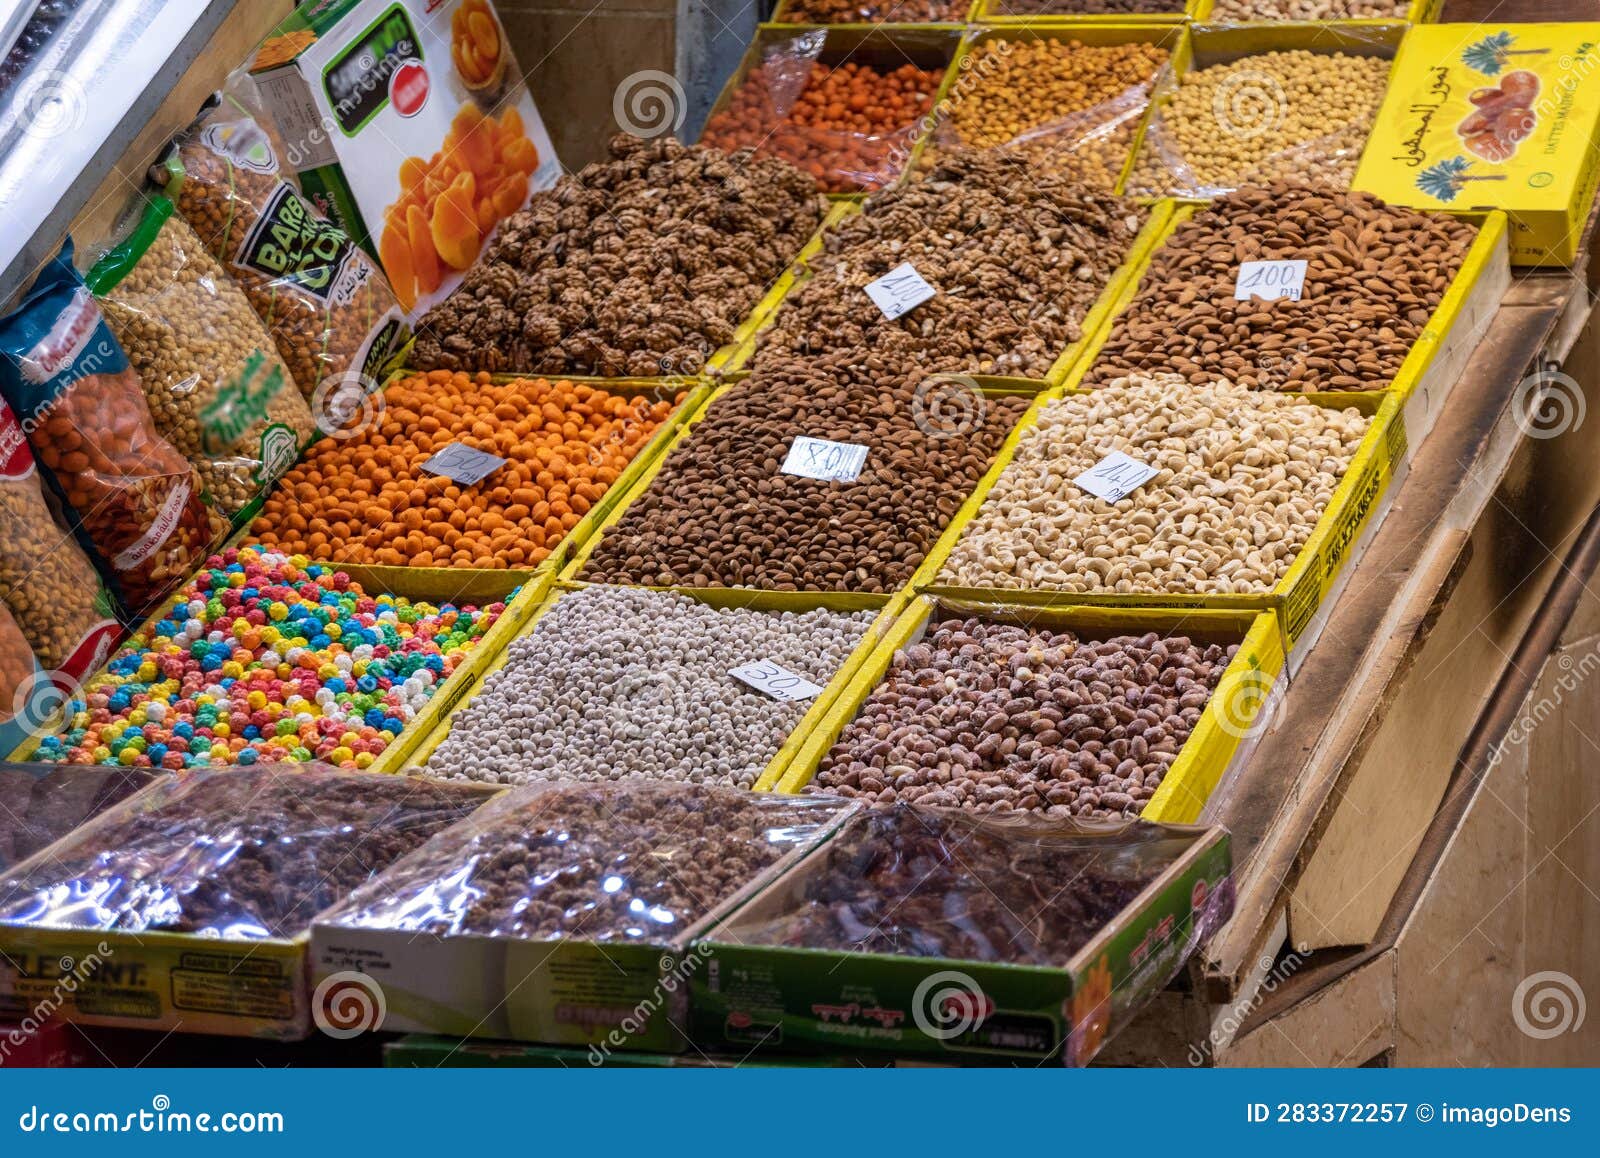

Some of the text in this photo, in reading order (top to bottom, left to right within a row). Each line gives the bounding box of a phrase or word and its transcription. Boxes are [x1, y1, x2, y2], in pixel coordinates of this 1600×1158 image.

[1391, 66, 1451, 167] تمور المجهول
[1239, 264, 1296, 288] 100
[438, 449, 489, 471] 50
[1094, 462, 1150, 488] 140
[743, 664, 801, 689] 30
